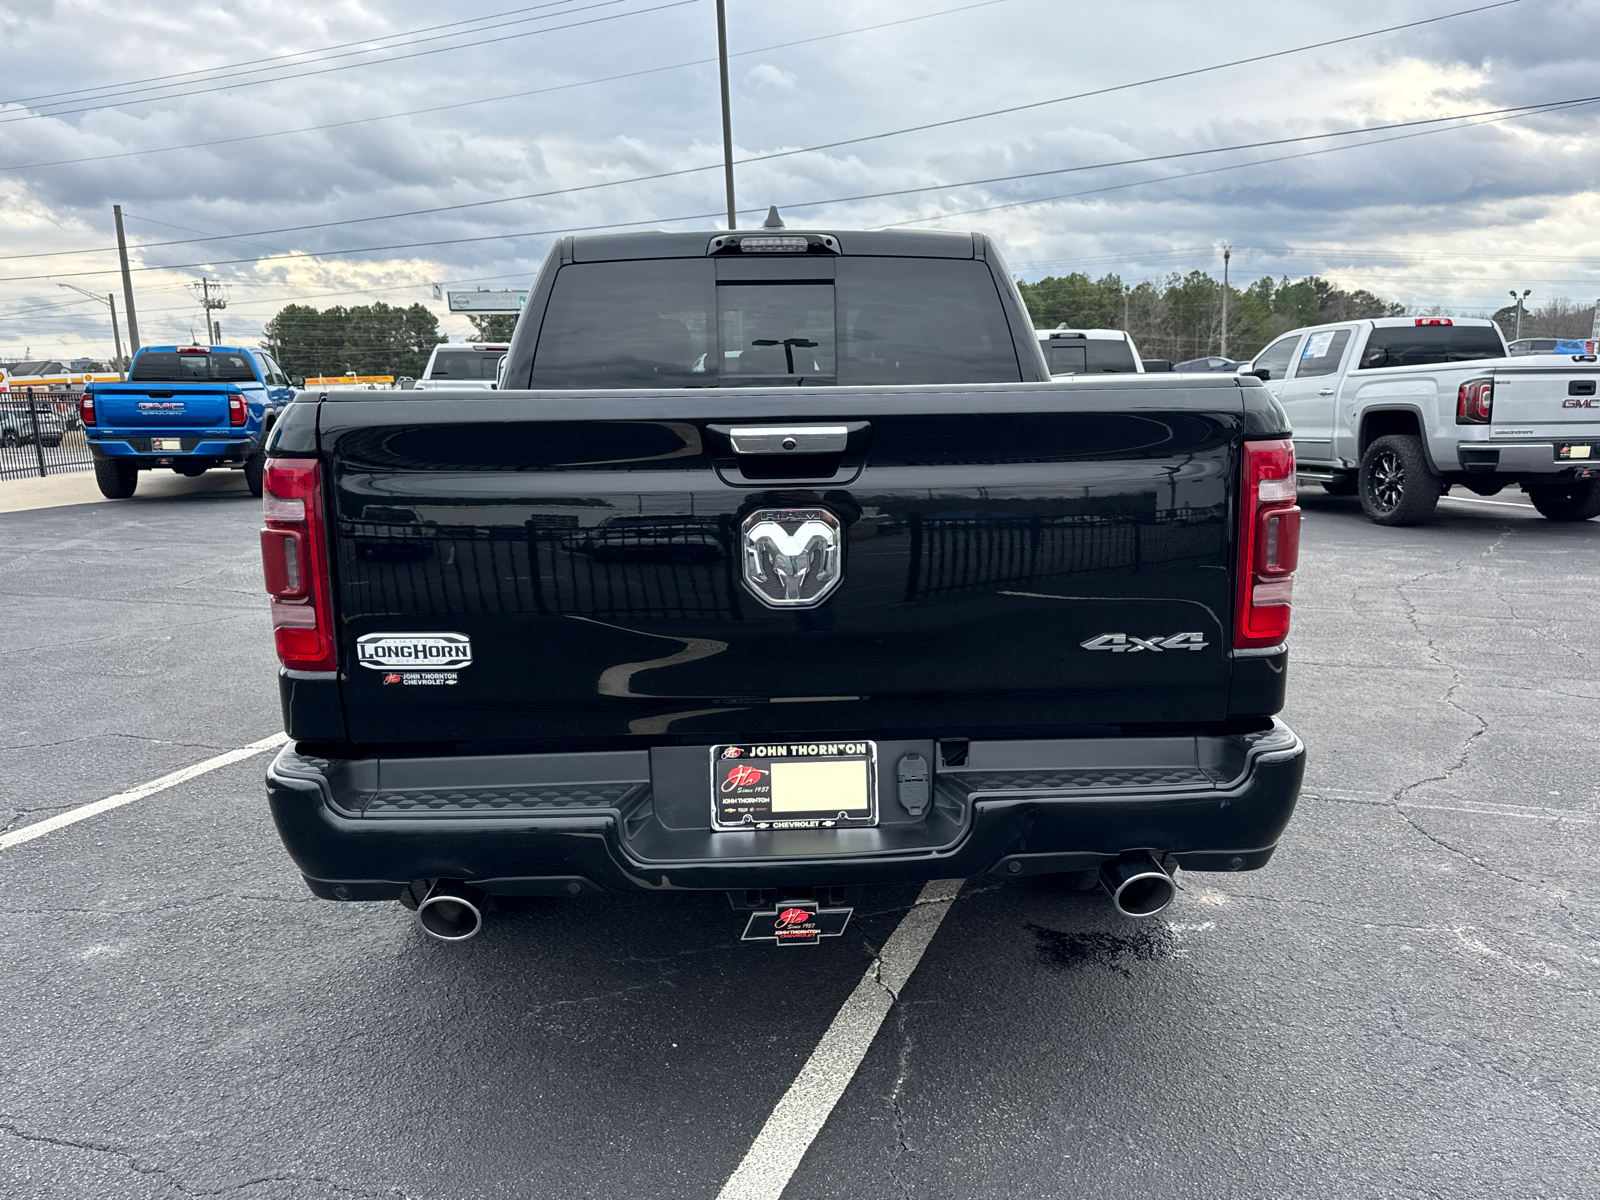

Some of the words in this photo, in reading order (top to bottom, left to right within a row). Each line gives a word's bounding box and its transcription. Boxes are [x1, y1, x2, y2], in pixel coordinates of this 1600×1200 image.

[138, 402, 185, 411] GMC
[1561, 398, 1600, 409] GMC
[761, 510, 820, 521] RAM
[749, 745, 788, 758] JOHN
[772, 821, 820, 829] CHEVROLET
